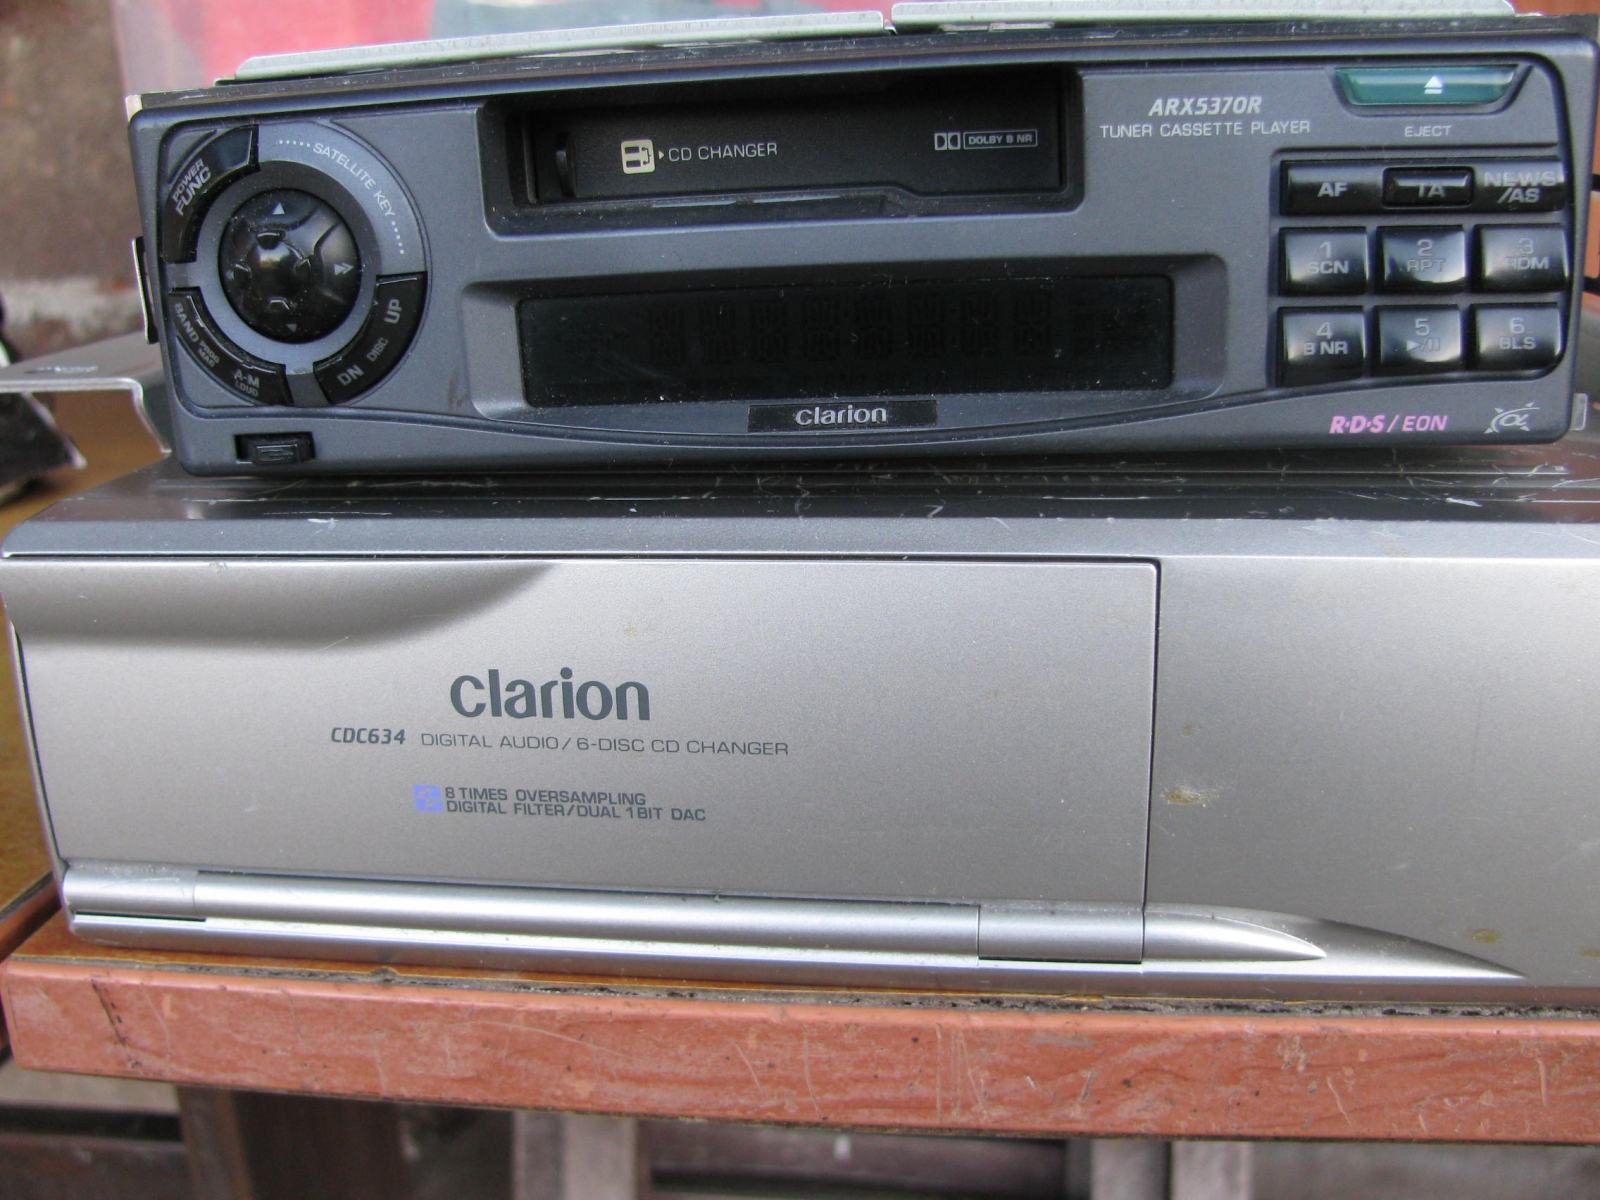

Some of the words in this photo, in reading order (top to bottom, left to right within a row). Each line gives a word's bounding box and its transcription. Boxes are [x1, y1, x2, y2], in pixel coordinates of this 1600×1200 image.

[1148, 96, 1263, 117] ARX5370R
[1100, 124, 1152, 138] TUNER
[1160, 122, 1242, 137] CASSETTE
[1251, 120, 1310, 135] PLAYER
[1404, 125, 1452, 138] EJECT
[968, 134, 1002, 145] DOLBY
[1016, 133, 1033, 144] NR
[668, 146, 692, 162] CD
[698, 142, 778, 161] CHANGER
[172, 158, 204, 201] POWER
[313, 142, 375, 191] SATELLITE
[374, 190, 396, 219] KEY
[1484, 171, 1557, 187] NEWS
[175, 166, 212, 217] FUNC
[1317, 182, 1349, 198] AF
[1417, 183, 1446, 198] TA
[1319, 241, 1333, 257] 1
[1416, 238, 1434, 257] 2
[1519, 238, 1535, 255] 3
[1307, 259, 1349, 275] SCN
[1406, 259, 1446, 273] RPT
[384, 299, 403, 325] UP
[175, 303, 199, 343] BAND
[1316, 321, 1333, 339] 4
[1415, 317, 1431, 336] 5
[1509, 317, 1526, 335] 6
[366, 337, 389, 364] DISC
[1320, 340, 1349, 355] NR
[1500, 336, 1537, 351] BLS
[336, 364, 365, 387] DN
[331, 727, 406, 745] CDC634
[421, 733, 492, 748] DIGITAL
[651, 739, 680, 753] CD
[686, 741, 789, 756] CHANGER
[445, 786, 455, 799] 8
[459, 787, 508, 801] TIMES
[515, 789, 647, 805] OVERSAMPLING
[447, 800, 507, 815] DIGITAL
[671, 808, 706, 822] DAC
